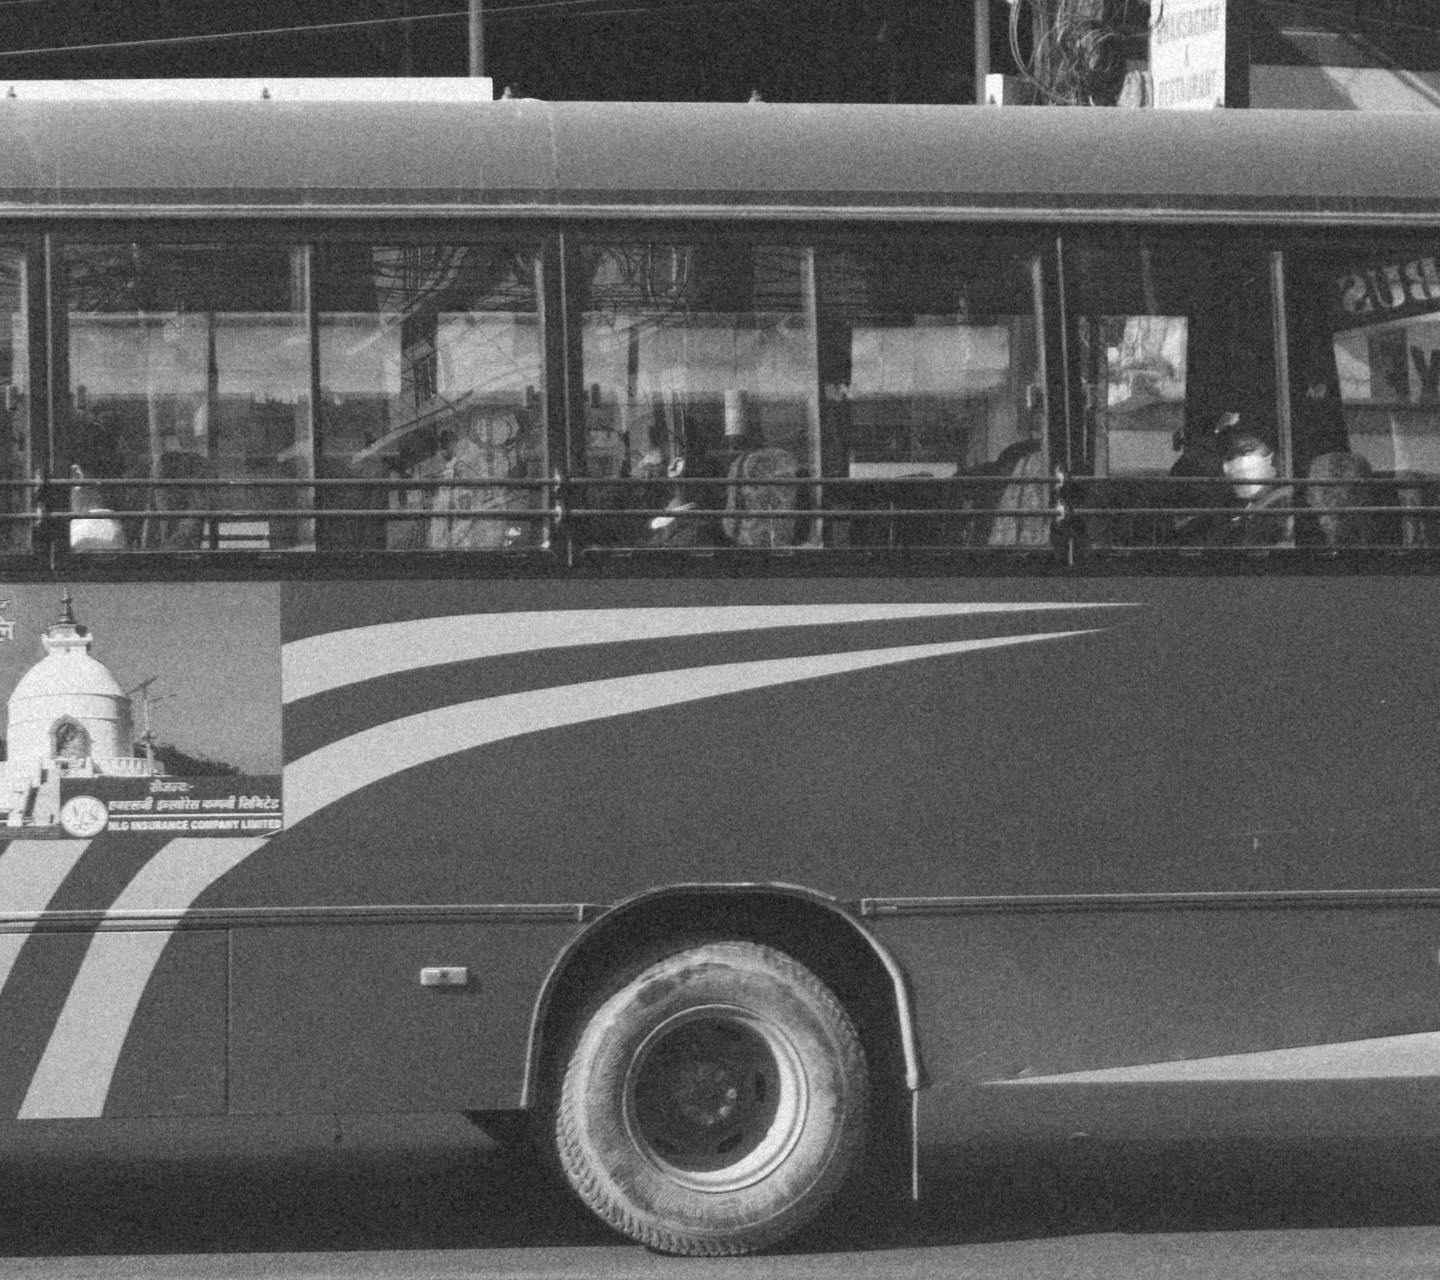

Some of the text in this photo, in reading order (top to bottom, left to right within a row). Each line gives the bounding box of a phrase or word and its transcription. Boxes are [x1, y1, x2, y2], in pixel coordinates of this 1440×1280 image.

[108, 819, 282, 831] NLG INSURANCE COMPANY LIMITED
